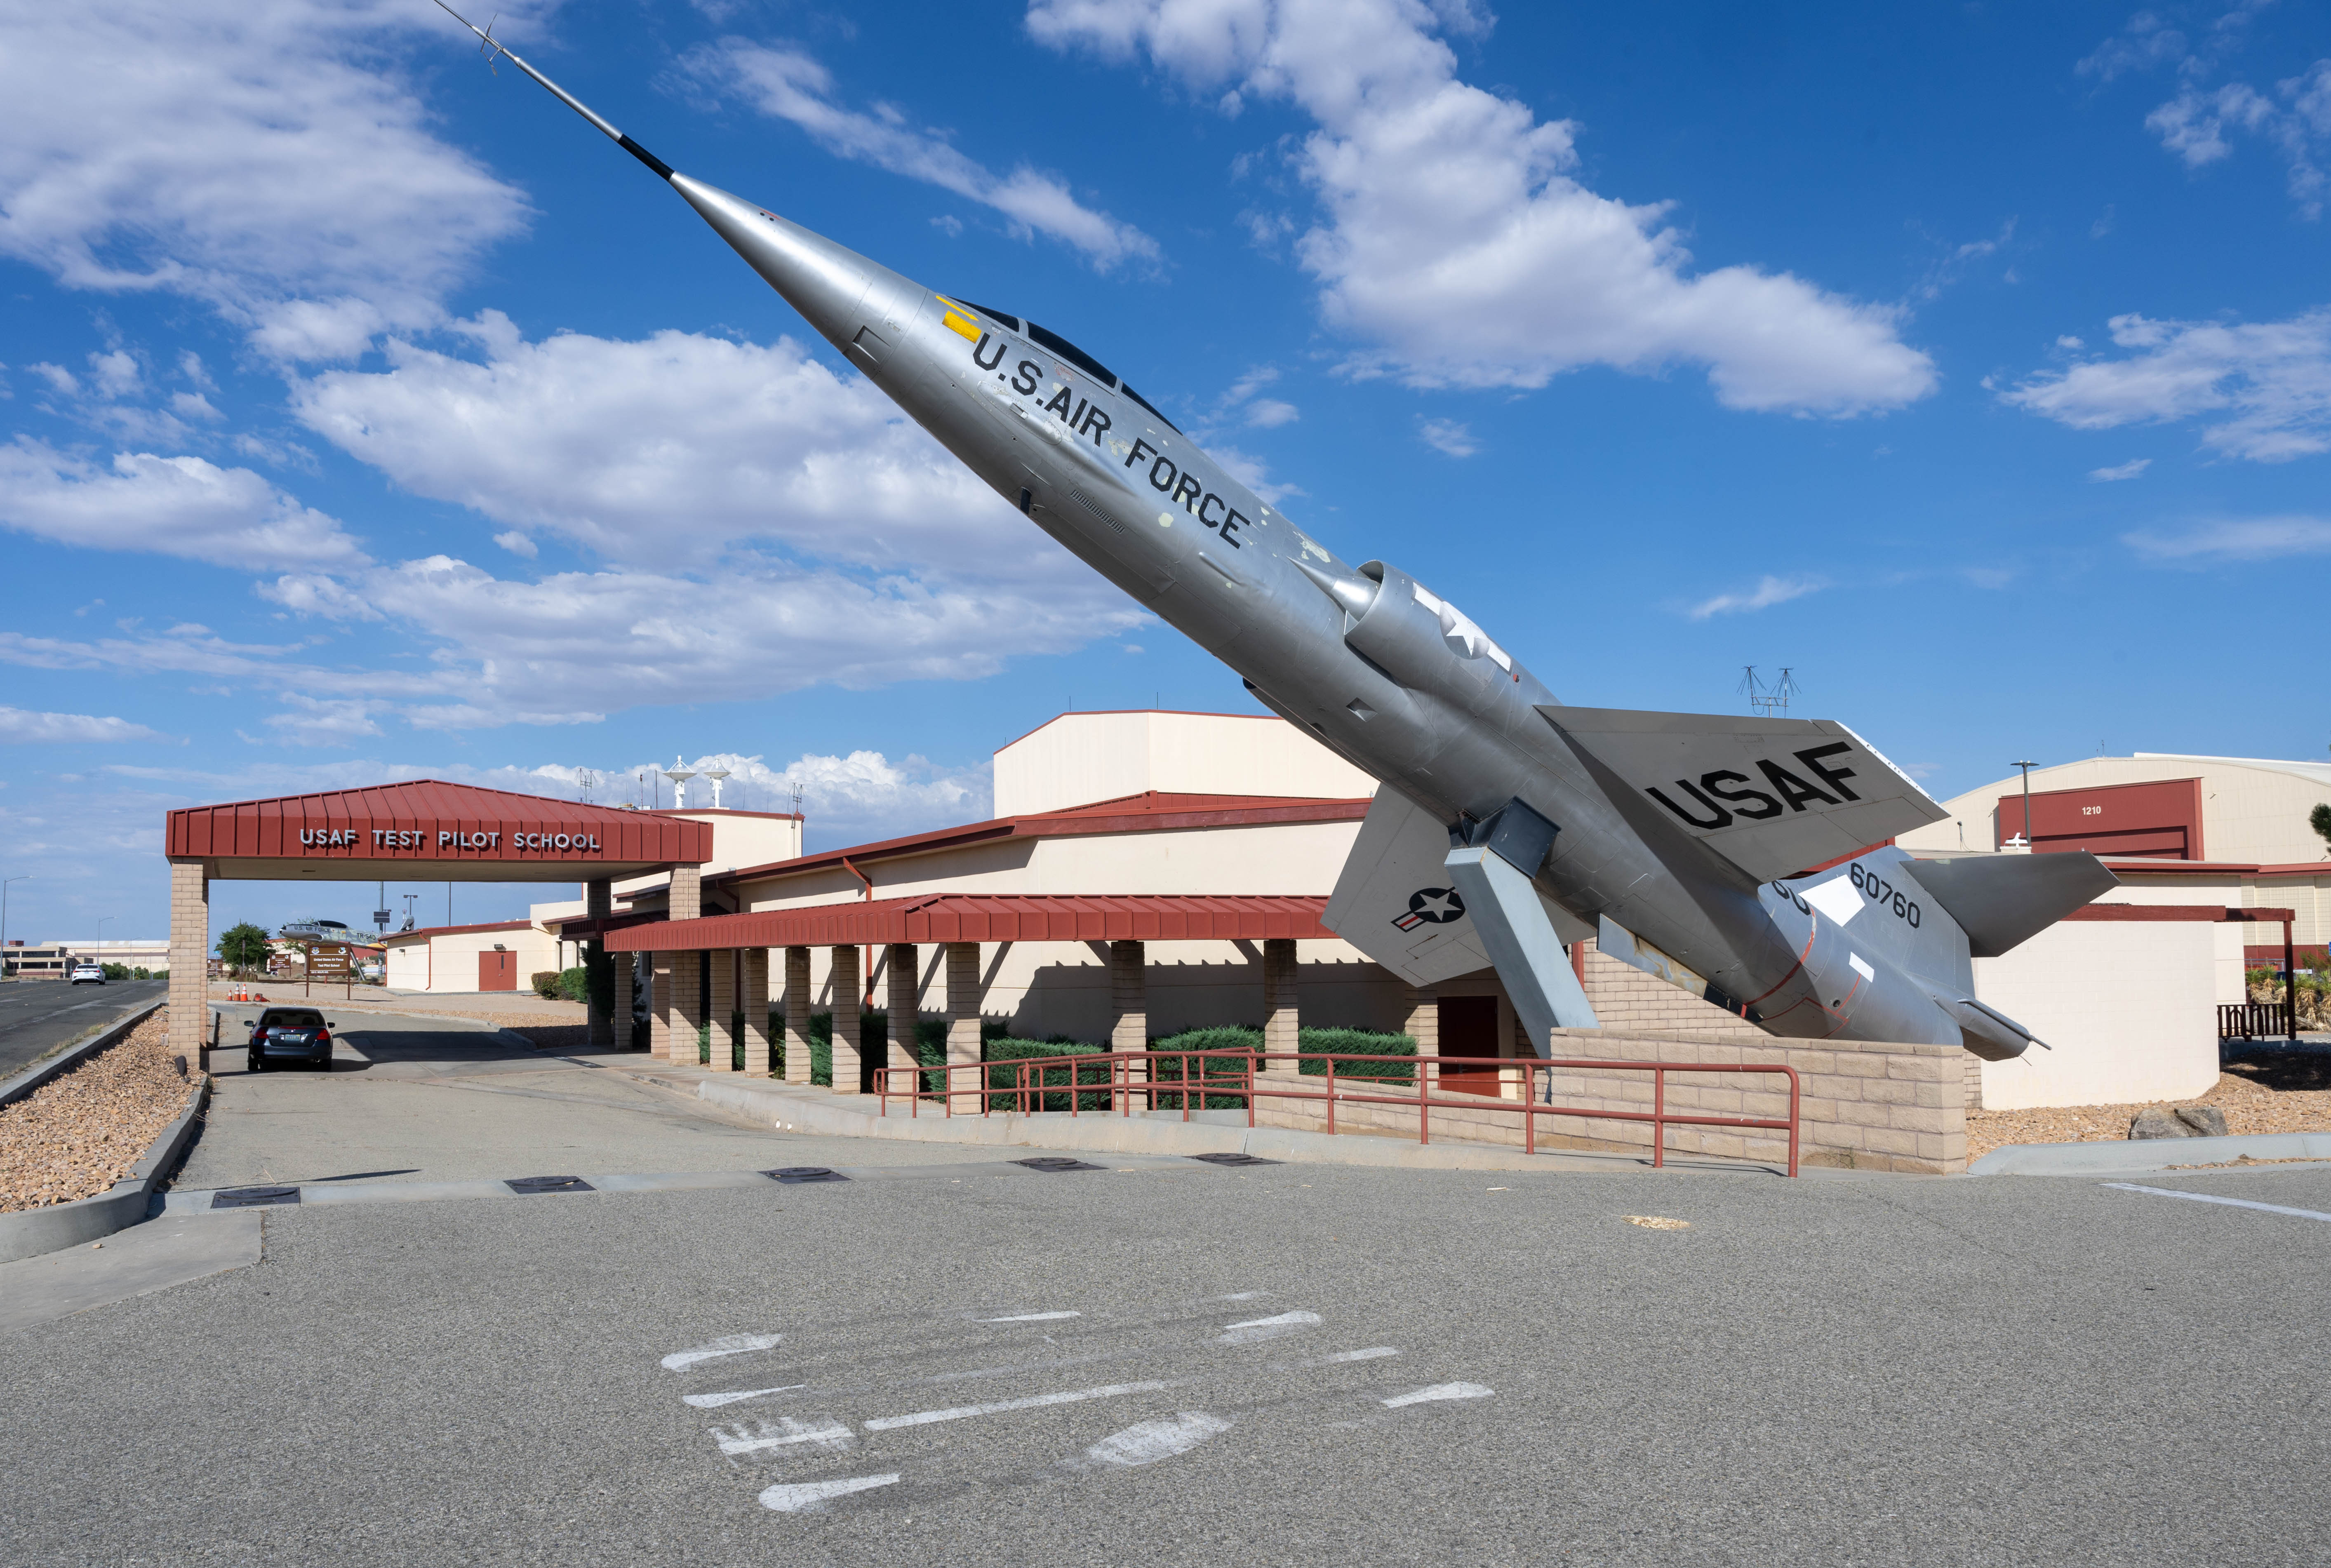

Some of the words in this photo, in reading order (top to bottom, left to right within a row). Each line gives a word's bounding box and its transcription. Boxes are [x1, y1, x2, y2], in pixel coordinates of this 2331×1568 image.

[1124, 437, 1251, 550] FORCE
[1644, 741, 1862, 830] USAF
[2082, 806, 2101, 815] 1210
[300, 829, 356, 844] USAF
[372, 830, 423, 845] TEST
[439, 831, 499, 846] PILOT
[514, 832, 600, 848] SCHOOL
[1850, 862, 1921, 929] 60760
